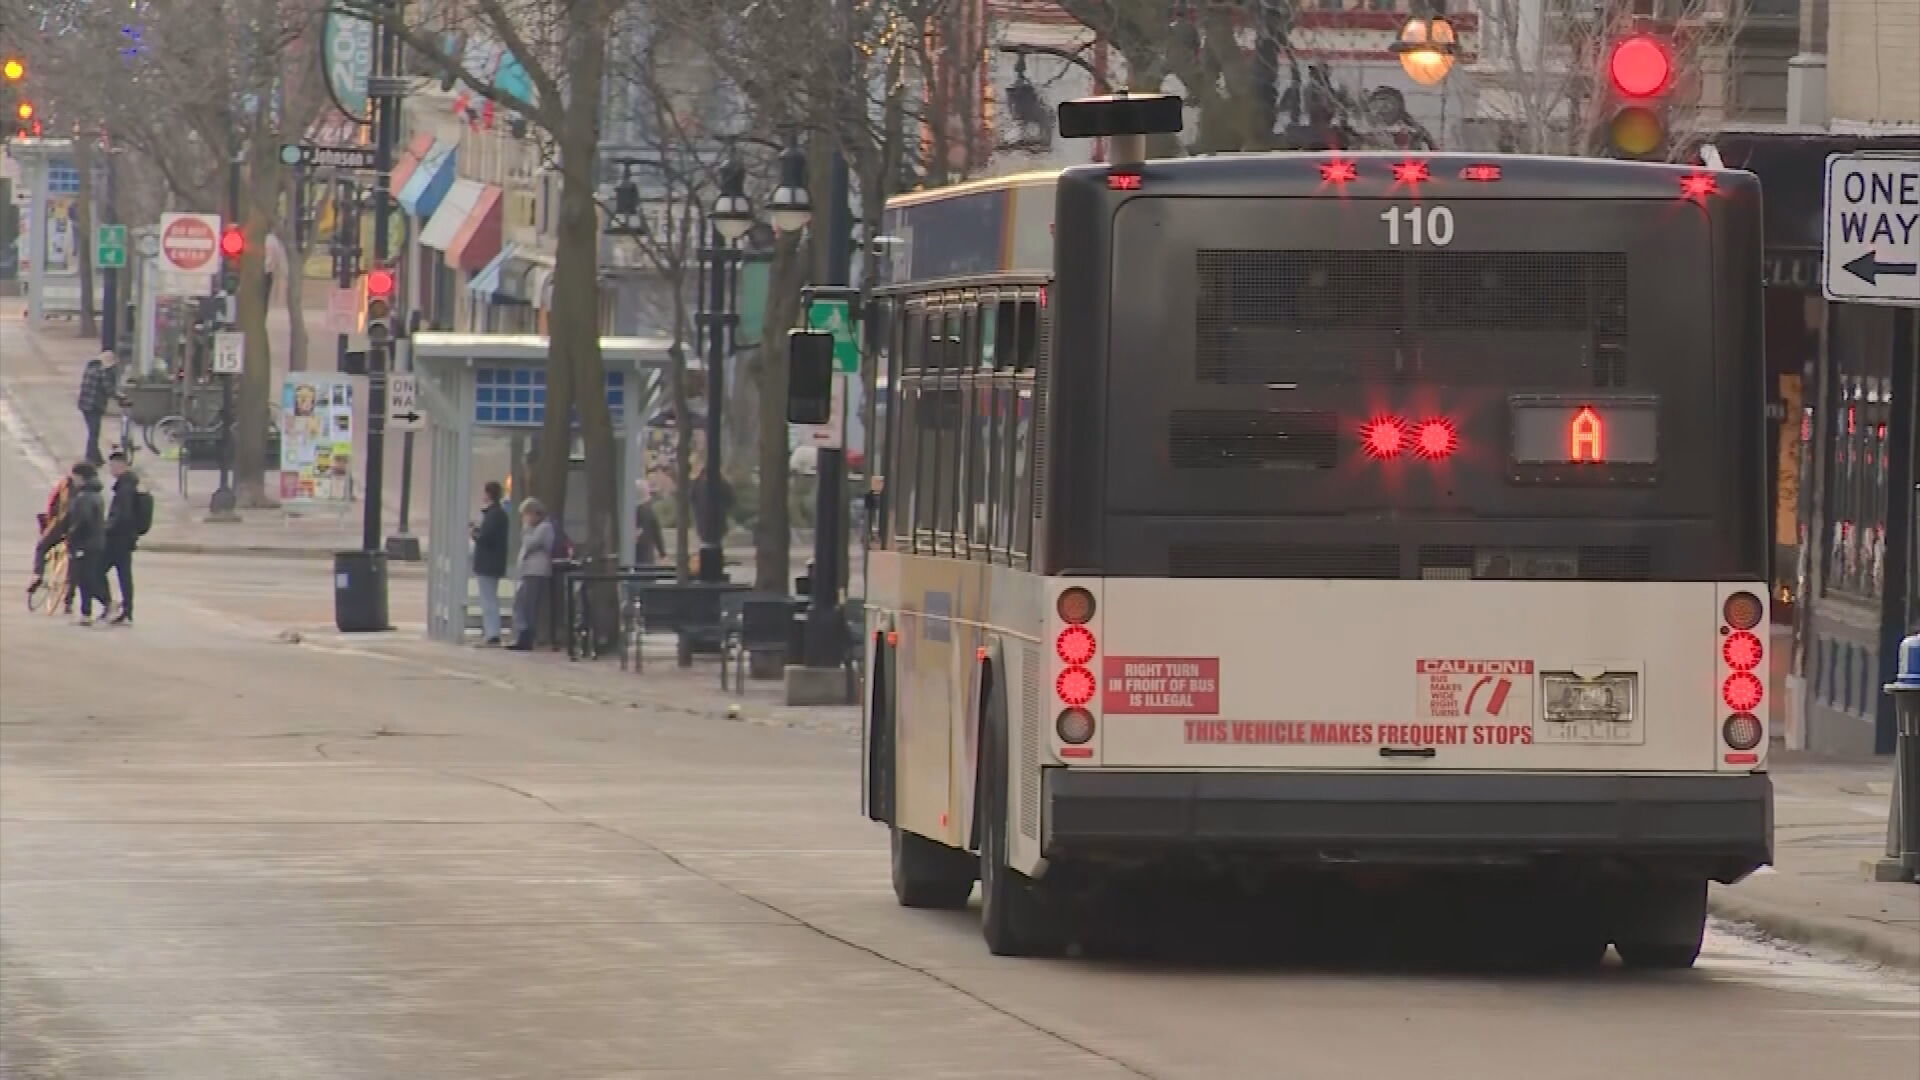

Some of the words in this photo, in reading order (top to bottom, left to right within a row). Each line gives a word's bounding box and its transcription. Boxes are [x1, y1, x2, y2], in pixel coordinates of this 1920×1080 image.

[1844, 172, 1919, 204] ONE
[1380, 206, 1454, 246] 110
[1841, 212, 1919, 244] WAY
[220, 352, 237, 368] 15
[393, 380, 414, 392] ON
[392, 396, 414, 407] WA
[1572, 408, 1601, 461] A
[1125, 664, 1163, 677] RIGHT
[1165, 664, 1199, 677] TURN
[1424, 660, 1526, 673] CAUTION!
[1109, 679, 1123, 692] IN
[1125, 679, 1166, 692] FRONT
[1169, 680, 1187, 692] OF
[1189, 680, 1216, 692] BUS
[1430, 675, 1448, 683] BUS
[1430, 683, 1462, 691] MAKES
[1129, 693, 1143, 706] IS
[1144, 693, 1194, 706] ILLEGAL
[1430, 700, 1459, 708] RIGHT
[1431, 709, 1460, 717] TURNS
[1184, 721, 1228, 742] THIS
[1231, 722, 1305, 743] VEHICLE
[1310, 723, 1373, 744] MAKES
[1378, 725, 1469, 745] FREQUENT
[1472, 725, 1533, 745] STOPS
